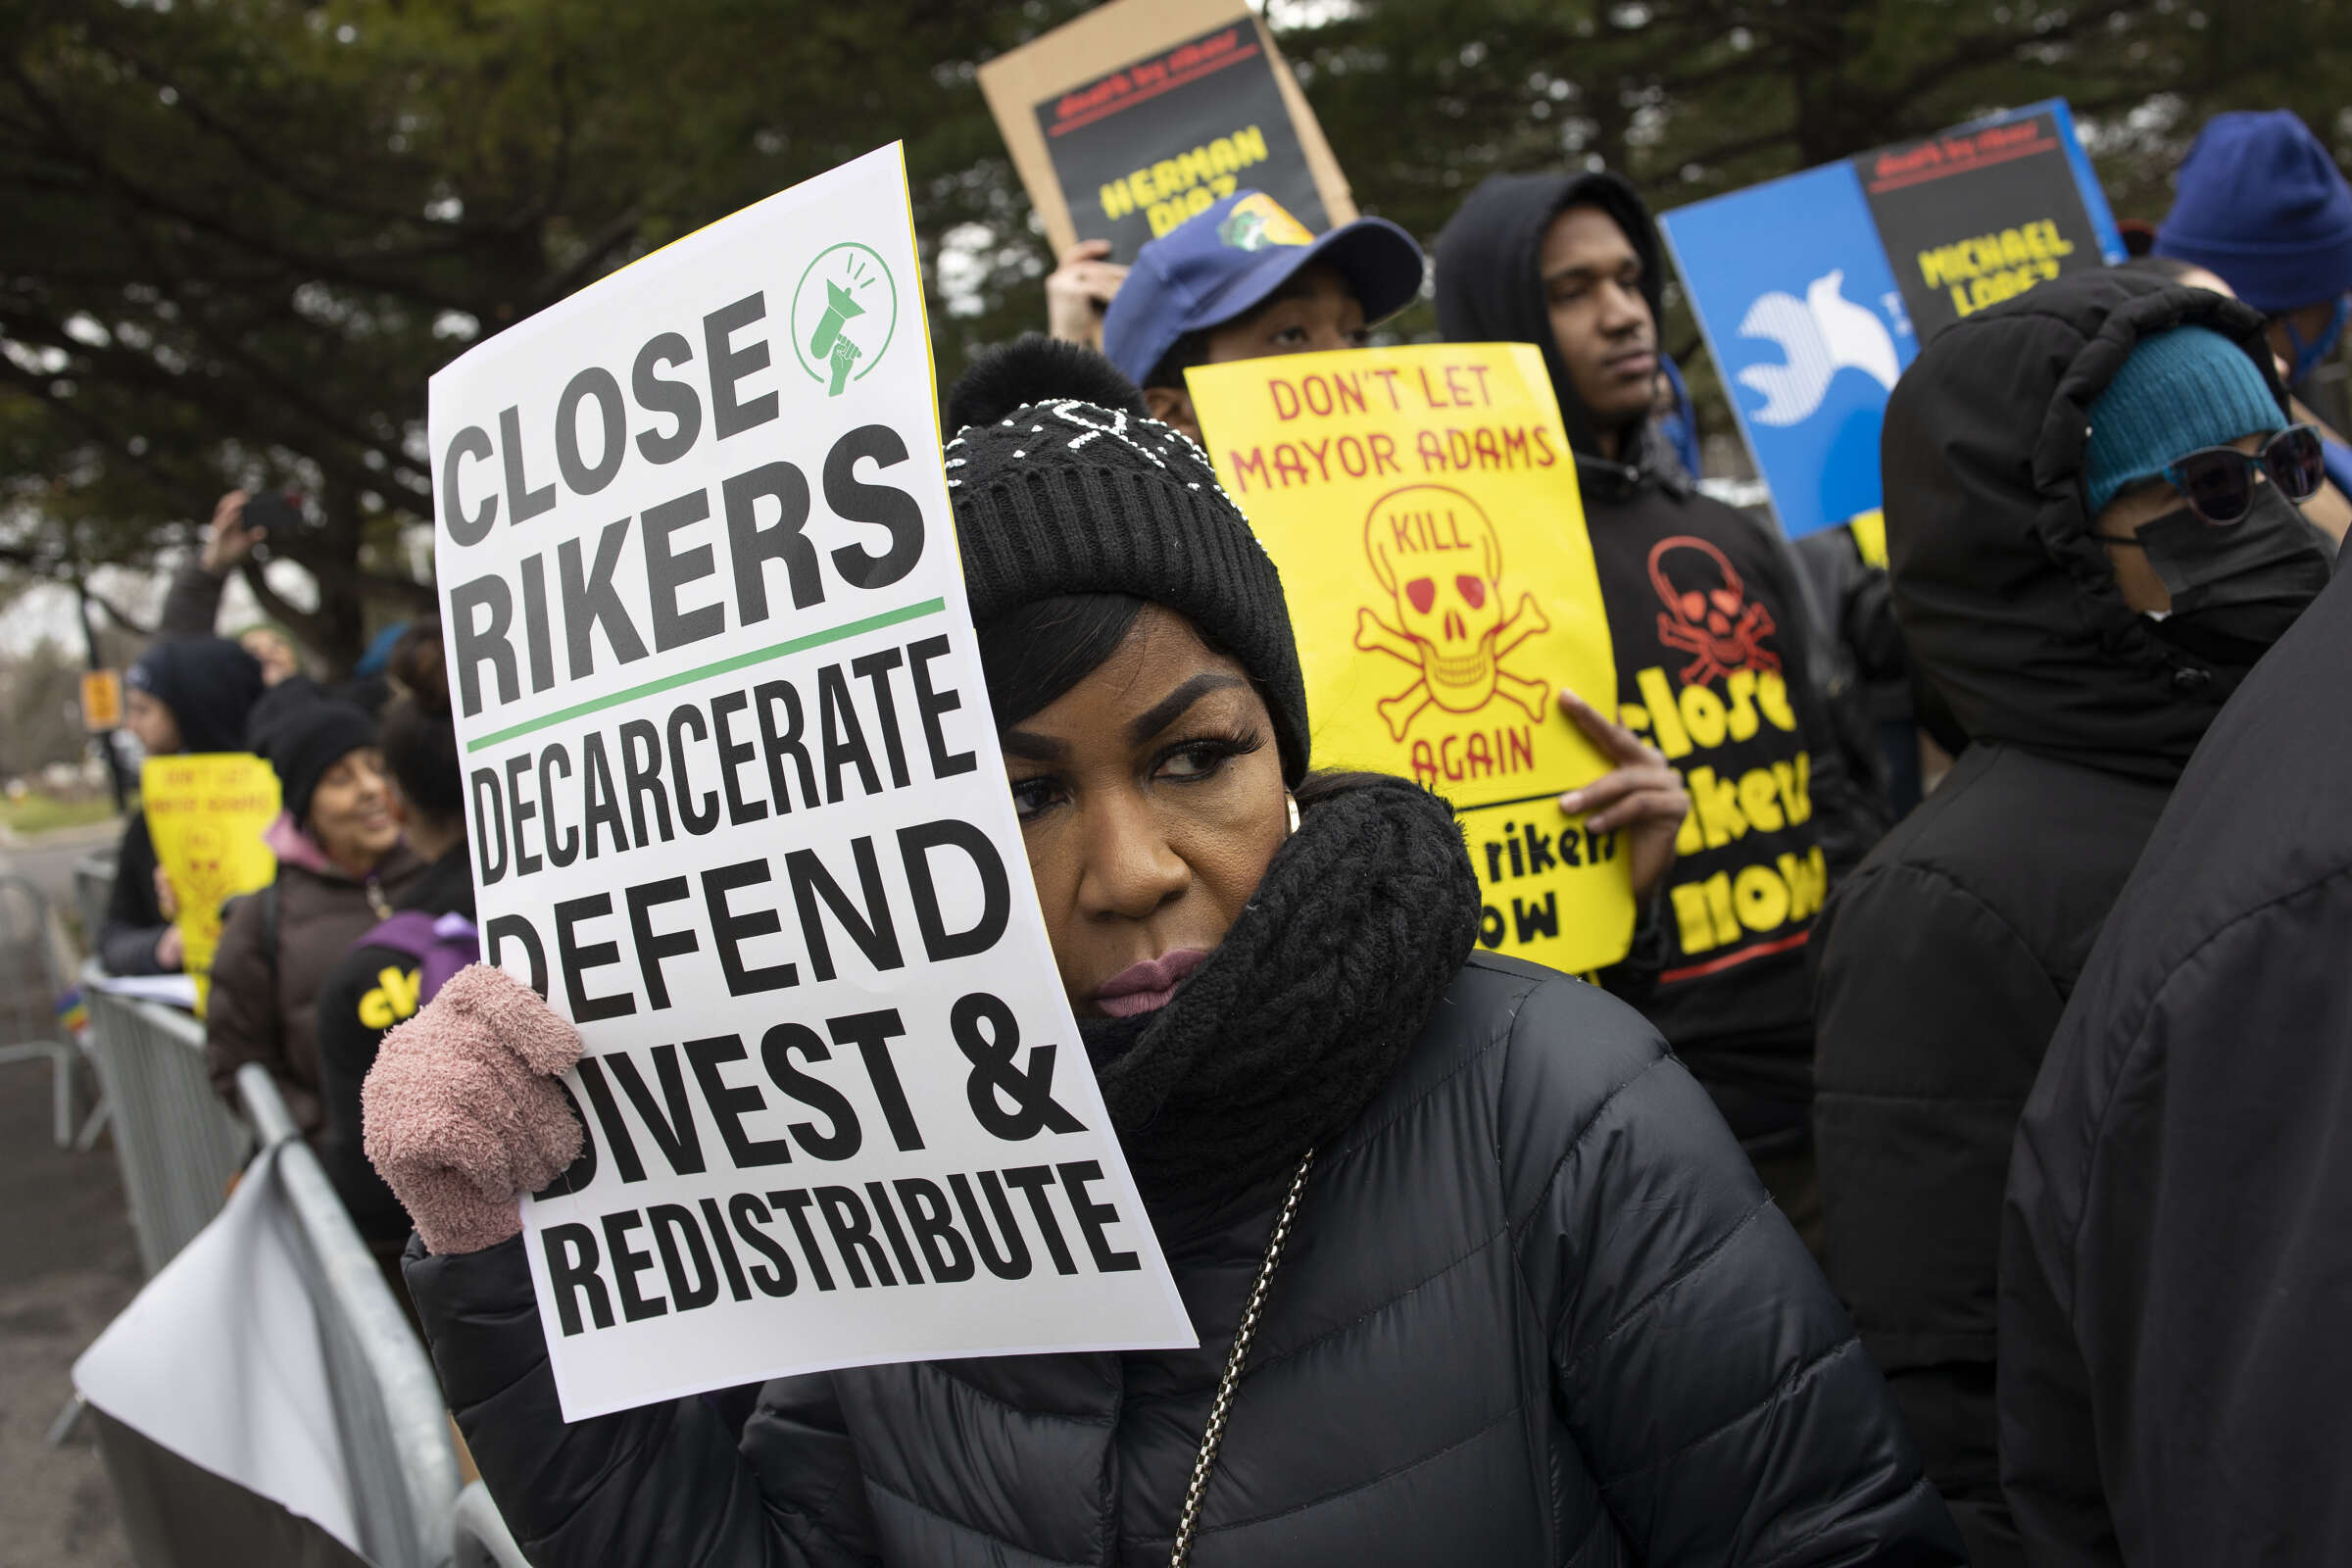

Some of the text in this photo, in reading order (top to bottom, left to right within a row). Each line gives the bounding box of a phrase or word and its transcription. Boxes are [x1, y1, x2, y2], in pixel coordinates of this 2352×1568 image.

[1100, 124, 1268, 220] HERMAN
[1918, 218, 2075, 289] MICHAEL
[443, 290, 780, 547] CLOSE
[1268, 366, 1491, 420] DON'T LET
[1229, 425, 1554, 493] MAYOR ADAMS
[450, 423, 925, 718] RIKERS
[1390, 511, 1473, 553] KILL
[470, 633, 977, 886] DECARCERATE
[1411, 725, 1533, 785] AGAIN
[486, 818, 1010, 1024] DEFEND
[950, 992, 1089, 1142] &
[541, 1159, 1142, 1337] REDISTRIBUTE
